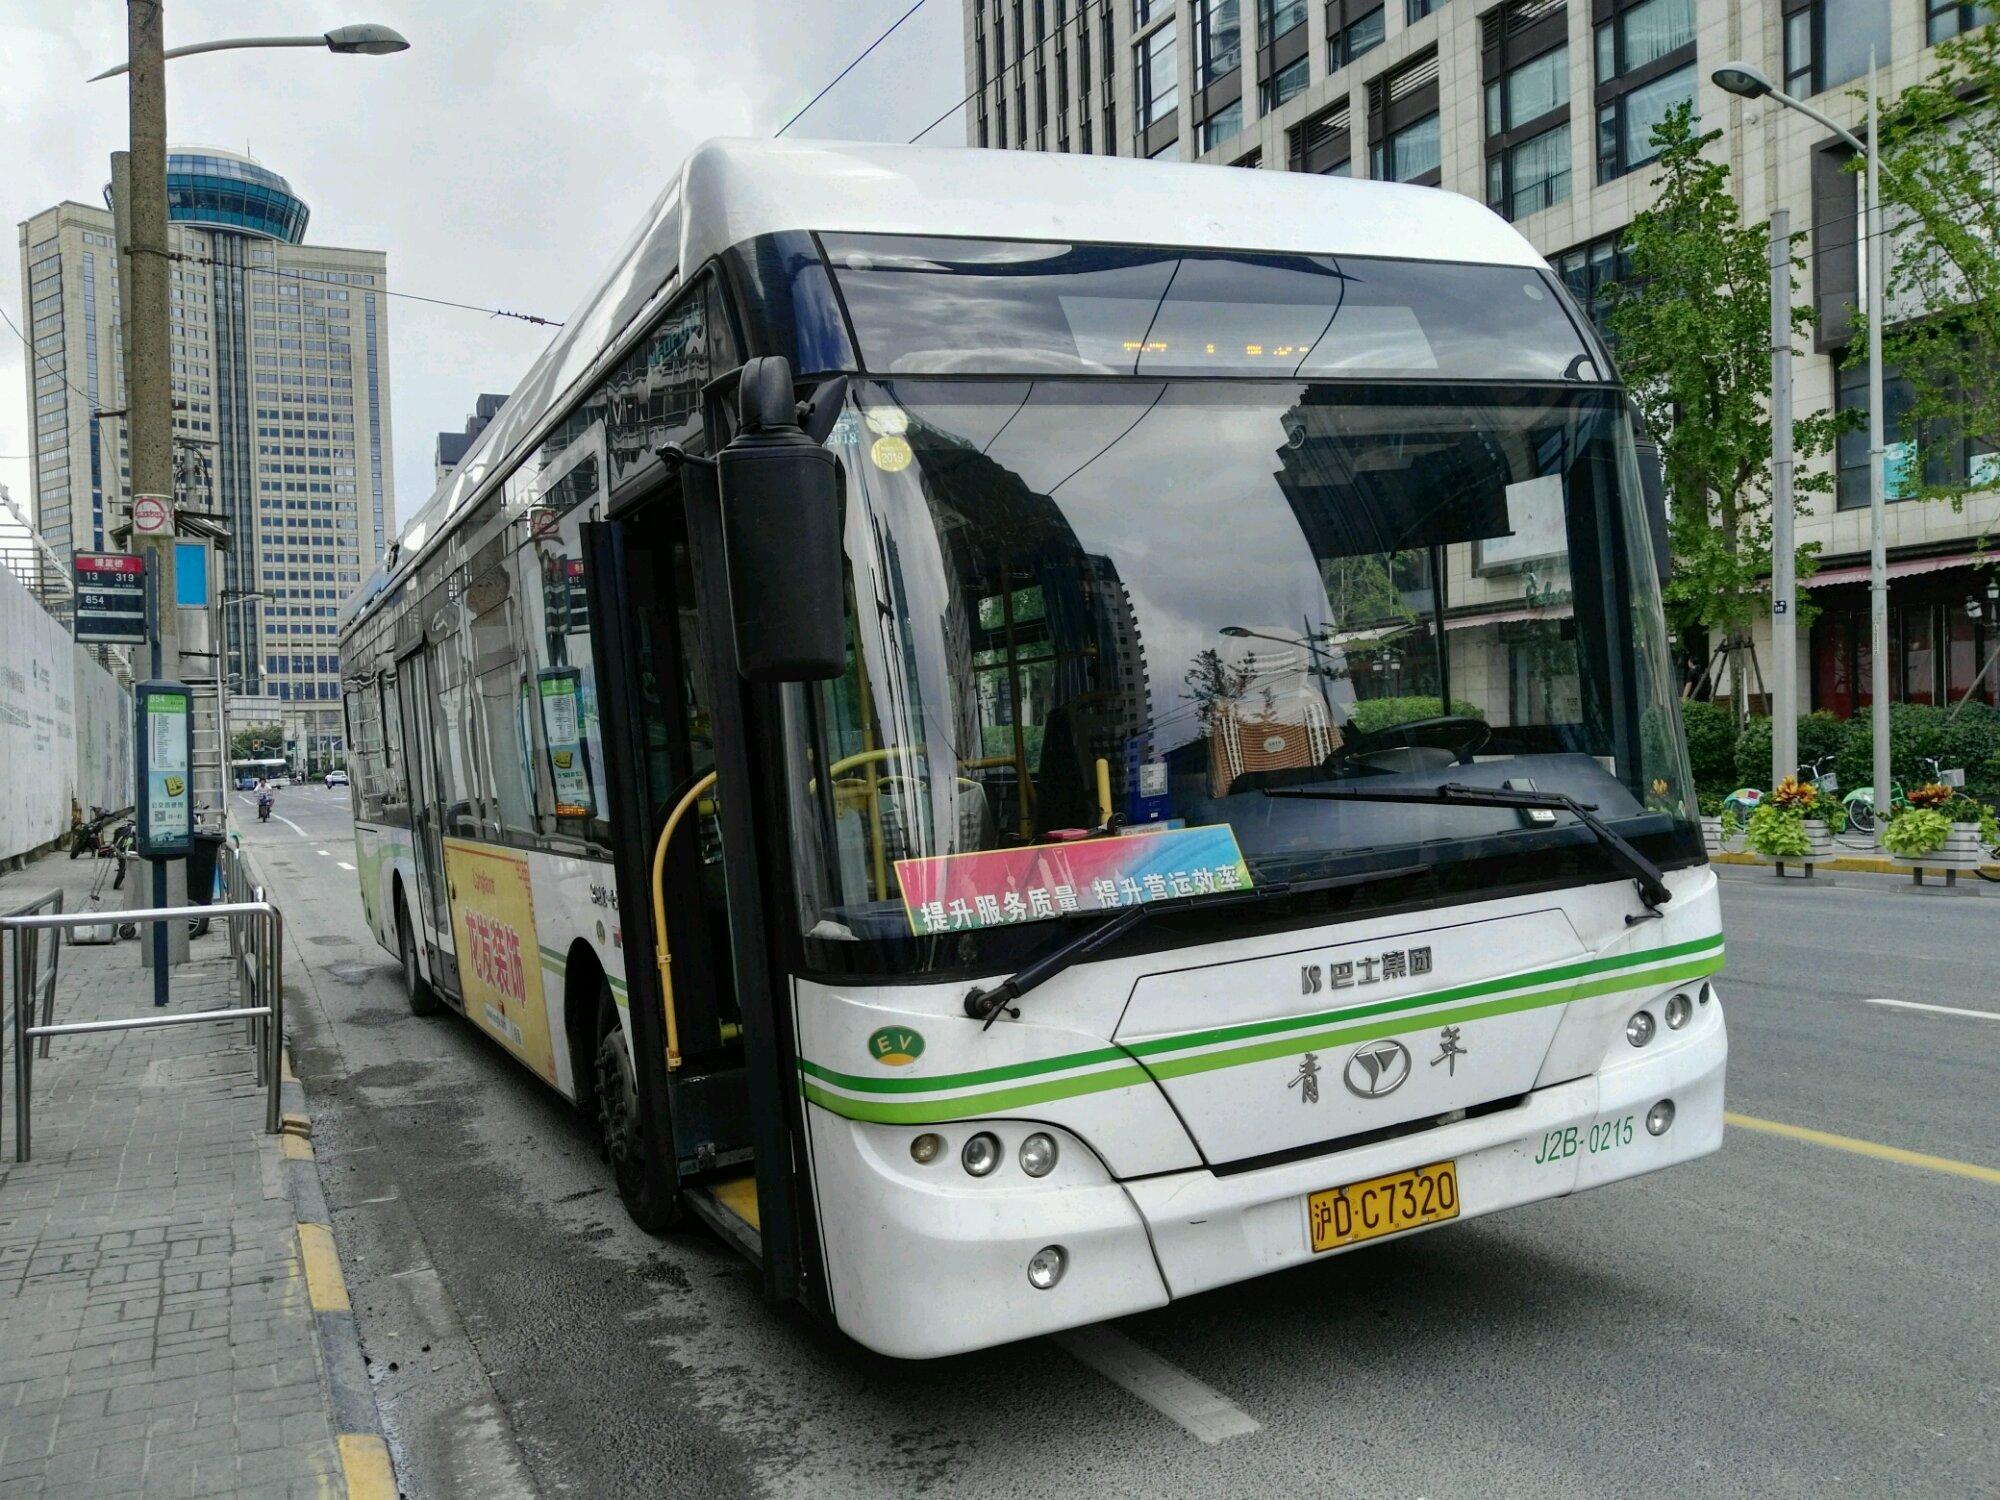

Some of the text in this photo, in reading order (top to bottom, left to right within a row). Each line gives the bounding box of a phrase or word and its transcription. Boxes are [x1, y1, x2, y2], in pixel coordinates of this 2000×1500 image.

[881, 452, 904, 463] 2019
[86, 572, 134, 582] 13 319
[85, 595, 104, 605] 854
[920, 864, 1242, 933] 提升服务质量 提升营运效率
[1330, 945, 1433, 990] 巴士集团
[877, 1034, 913, 1054] EV
[1535, 1116, 1634, 1165] J2B-0215
